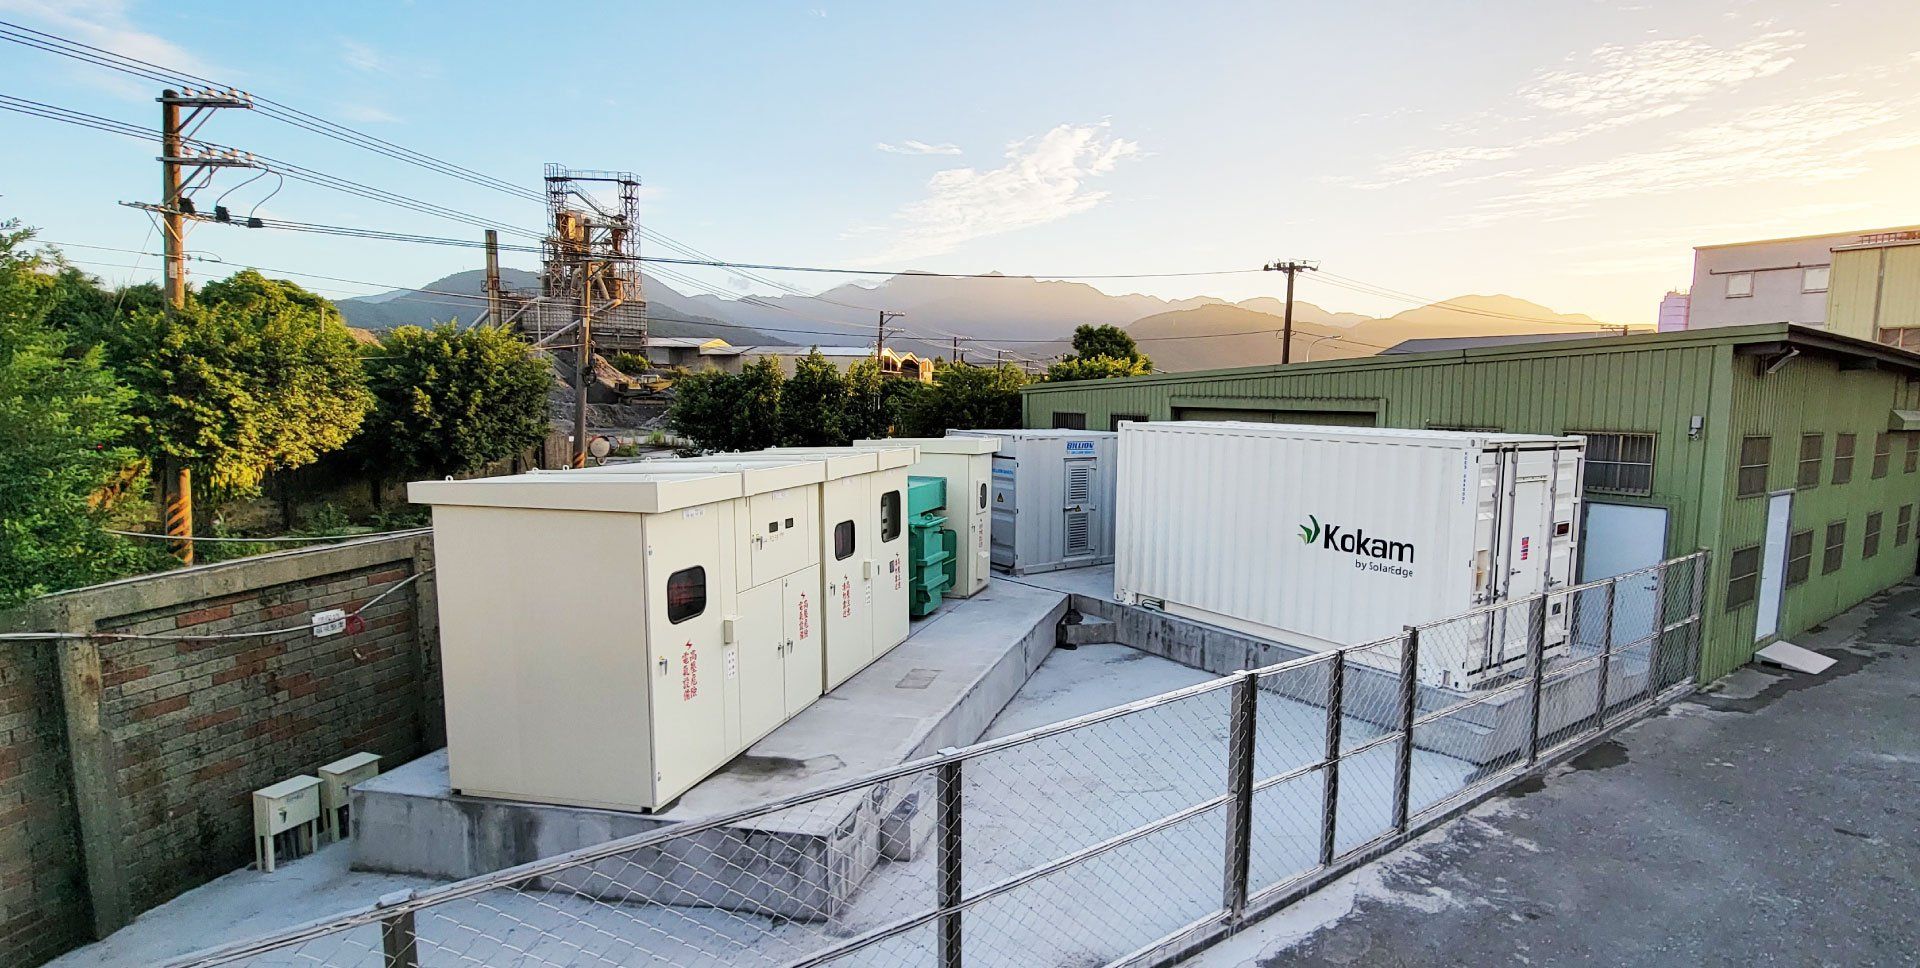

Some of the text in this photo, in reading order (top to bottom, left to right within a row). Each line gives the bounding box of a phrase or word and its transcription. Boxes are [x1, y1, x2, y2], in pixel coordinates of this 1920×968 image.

[1323, 524, 1415, 563] Kokam
[1355, 559, 1414, 579] by SolarEdge
